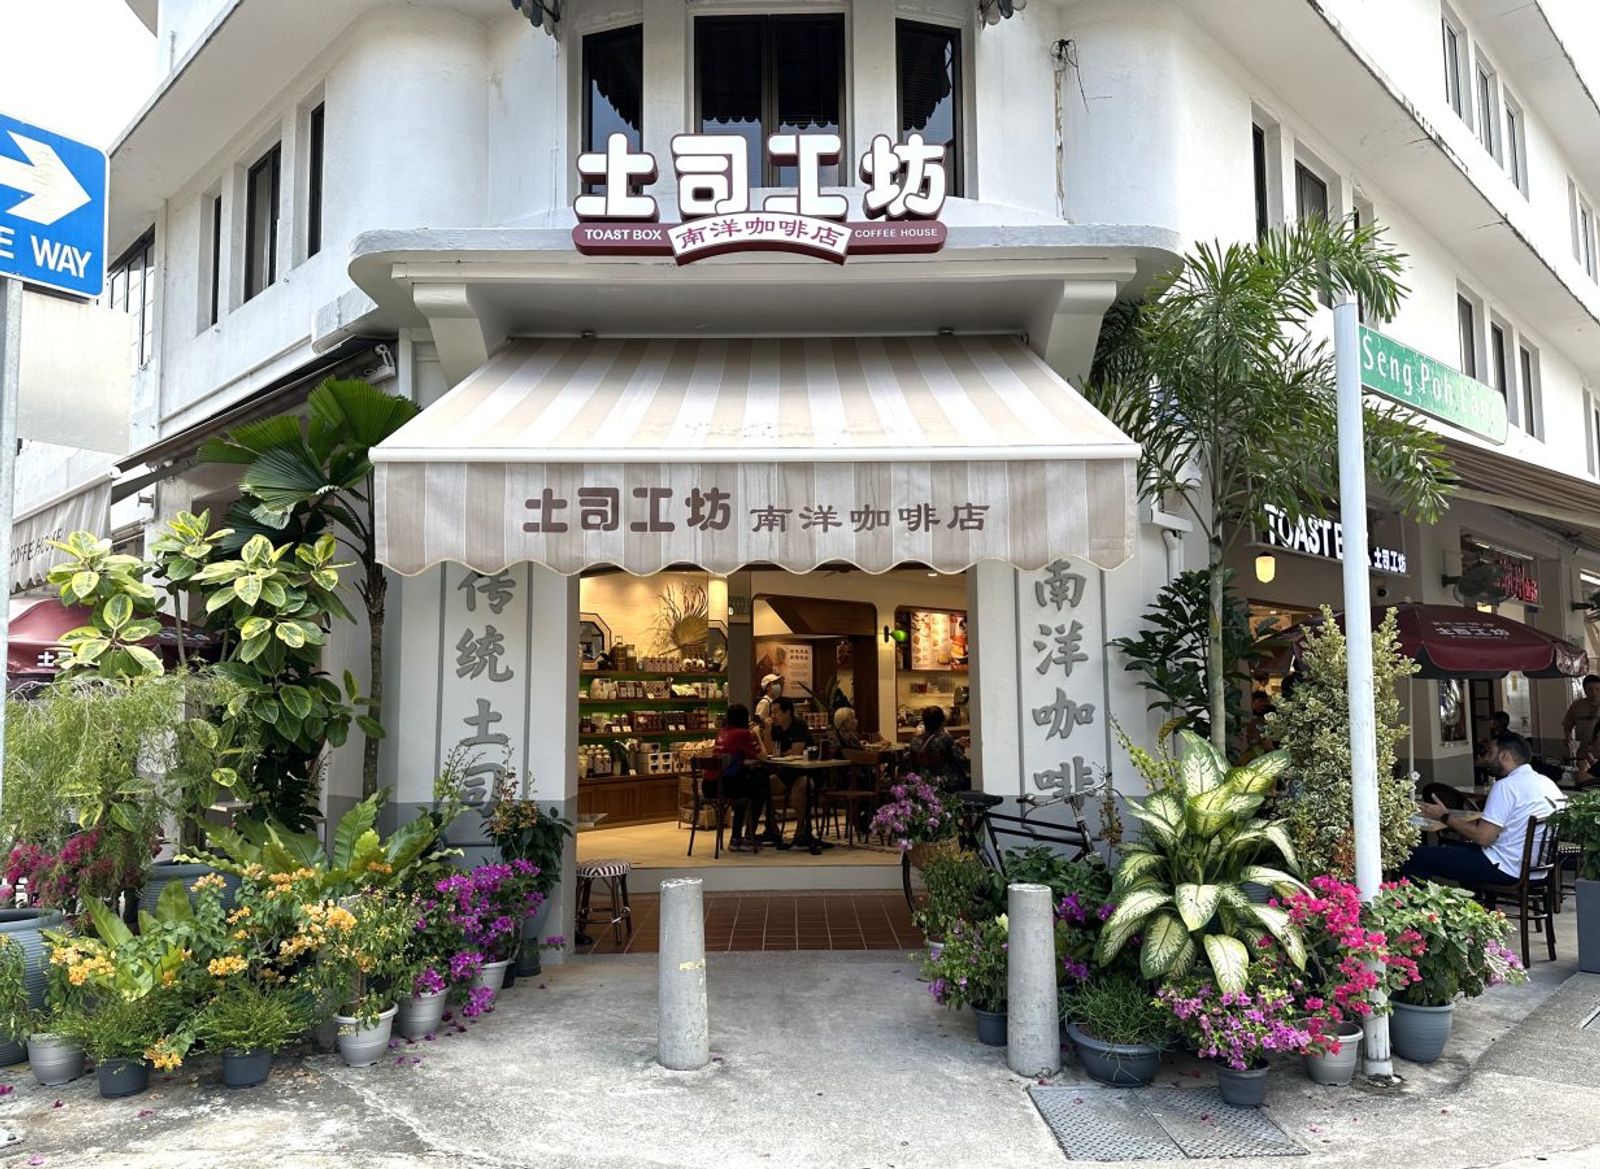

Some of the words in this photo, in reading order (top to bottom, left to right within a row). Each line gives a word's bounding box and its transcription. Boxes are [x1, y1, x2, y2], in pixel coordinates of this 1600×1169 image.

[574, 132, 948, 221] 土司工坊
[584, 228, 631, 240] TOAST
[633, 228, 662, 240] BOX
[679, 217, 845, 249] 南洋咖啡店
[854, 229, 896, 238] COFFEE
[900, 228, 939, 238] HOUSE
[30, 234, 92, 278] WAY
[1362, 335, 1413, 396] Seng
[1420, 361, 1453, 406] Poh
[523, 487, 732, 533] 土司工坊
[749, 503, 990, 533] 南洋咖啡店
[457, 569, 517, 818] 传统土司
[1032, 558, 1096, 808] 南洋咖啡
